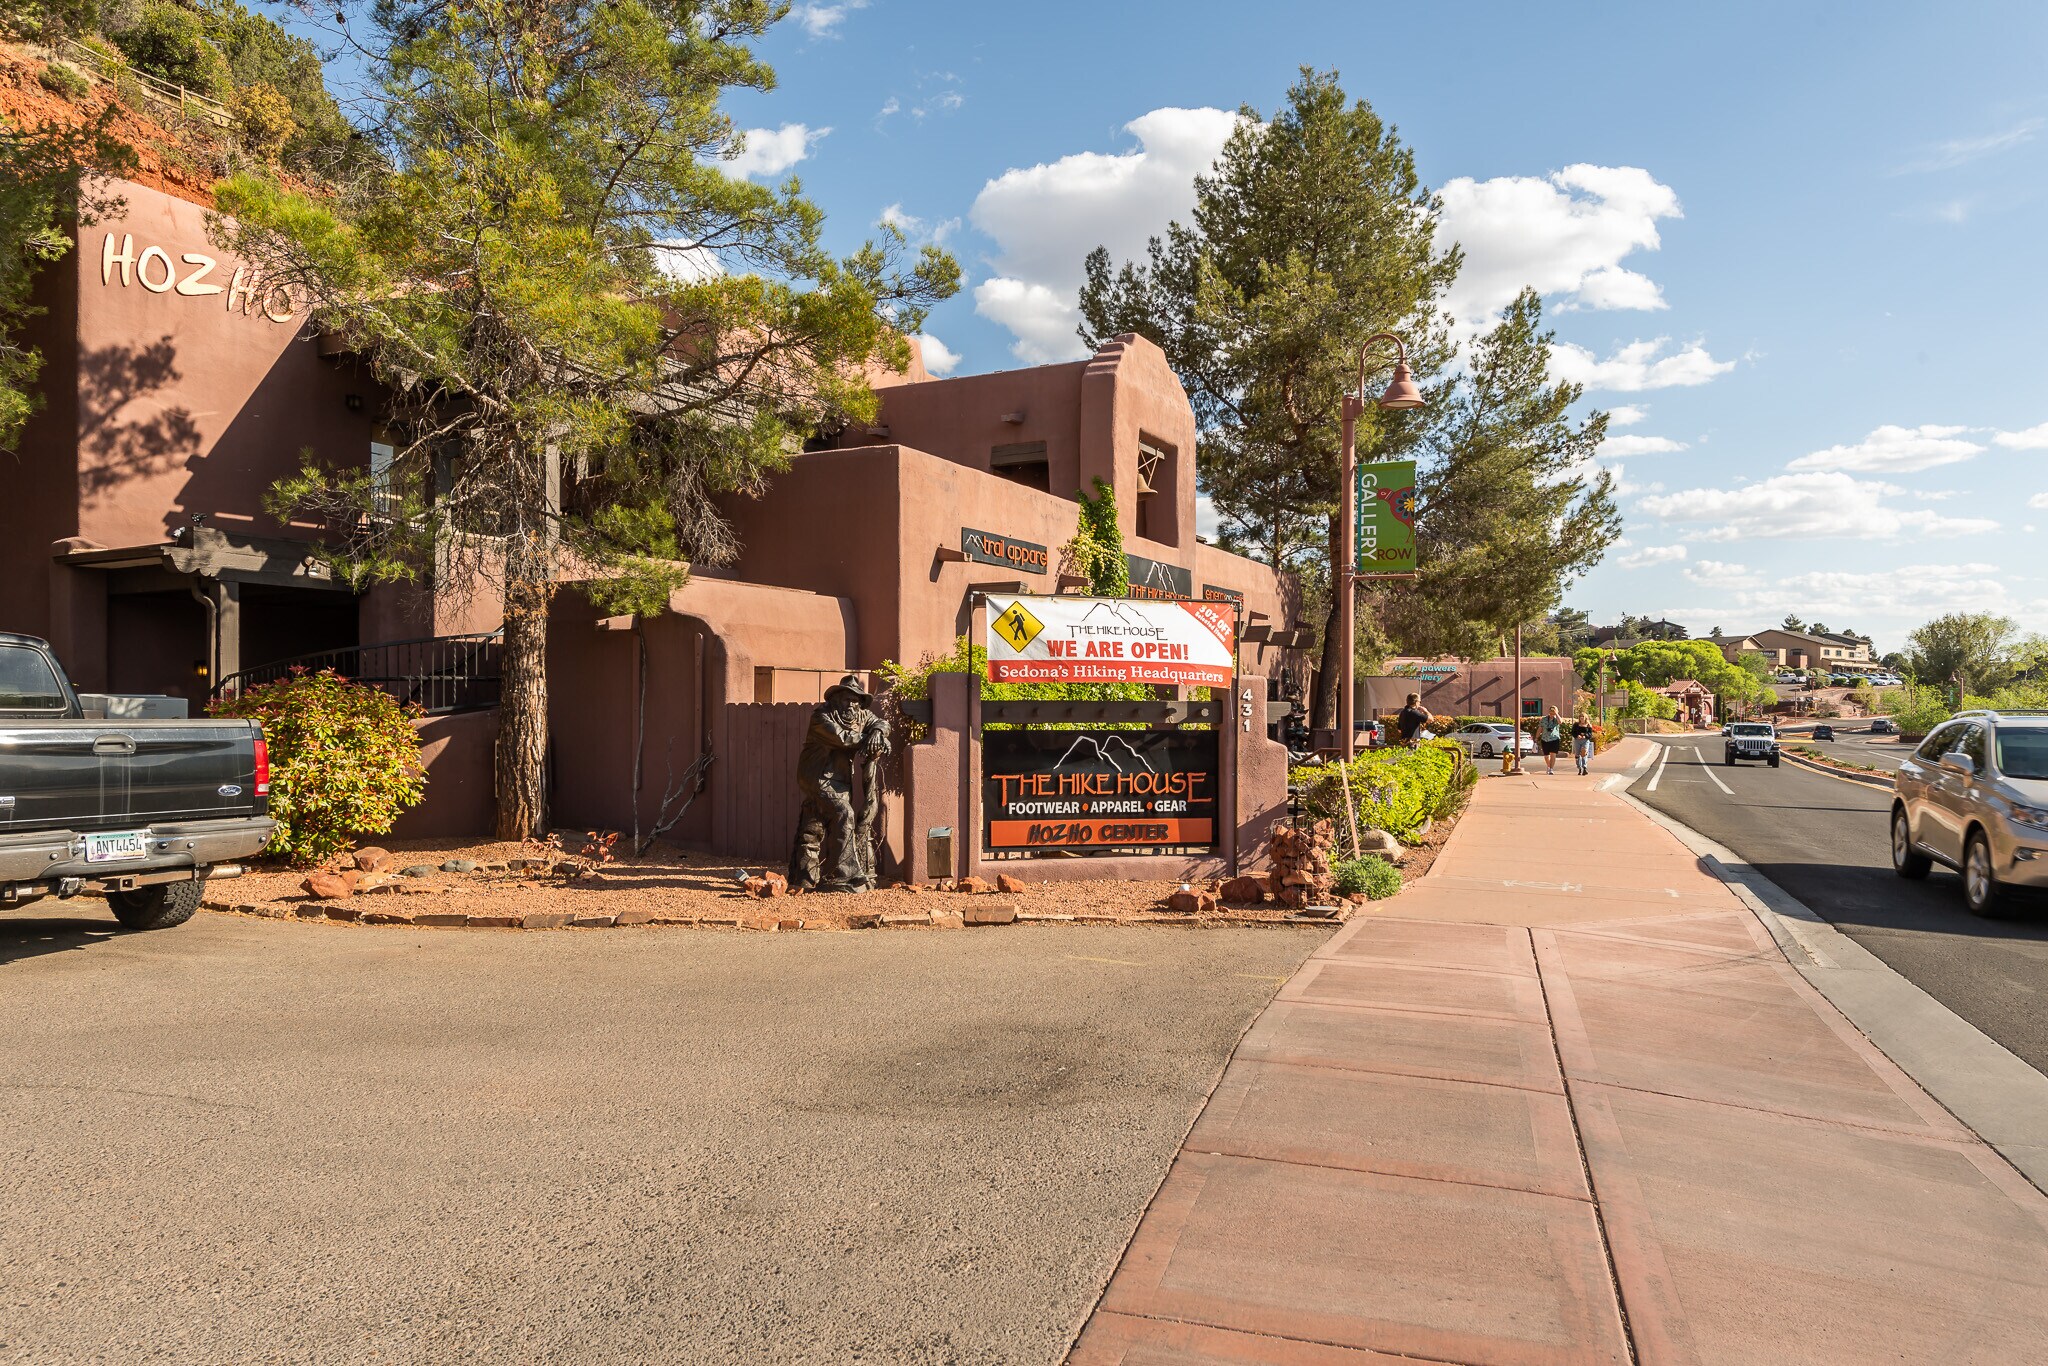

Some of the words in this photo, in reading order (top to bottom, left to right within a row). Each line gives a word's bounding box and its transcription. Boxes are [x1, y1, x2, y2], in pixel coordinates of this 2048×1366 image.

[102, 231, 294, 323] HOZHO
[1360, 473, 1378, 561] GALLERY
[983, 535, 1004, 558] trail
[1377, 547, 1413, 560] ROW
[1199, 604, 1219, 623] 30%
[1217, 619, 1232, 637] OFF
[1067, 625, 1093, 638] THE
[1096, 625, 1120, 636] HIKE
[1121, 626, 1168, 641] HOUSE
[1047, 640, 1078, 657] WE
[1085, 641, 1124, 658] ARE
[1131, 642, 1189, 660] OPEN!
[999, 665, 1069, 679] Sedona's
[1073, 665, 1127, 680] Hiking
[1131, 666, 1224, 683] Headquarters
[1410, 673, 1443, 682] llery
[1242, 688, 1253, 732] 431
[991, 773, 1058, 807] THE
[1059, 773, 1114, 795] HIKE
[1117, 772, 1213, 803] HOUSE
[1008, 802, 1080, 814] FOOTWEAR
[1090, 801, 1144, 814] APPAREL
[1154, 800, 1187, 812] GEAR
[1026, 823, 1093, 844] HOZHO
[1101, 823, 1168, 842] CENTER
[96, 838, 142, 854] ANT4454
